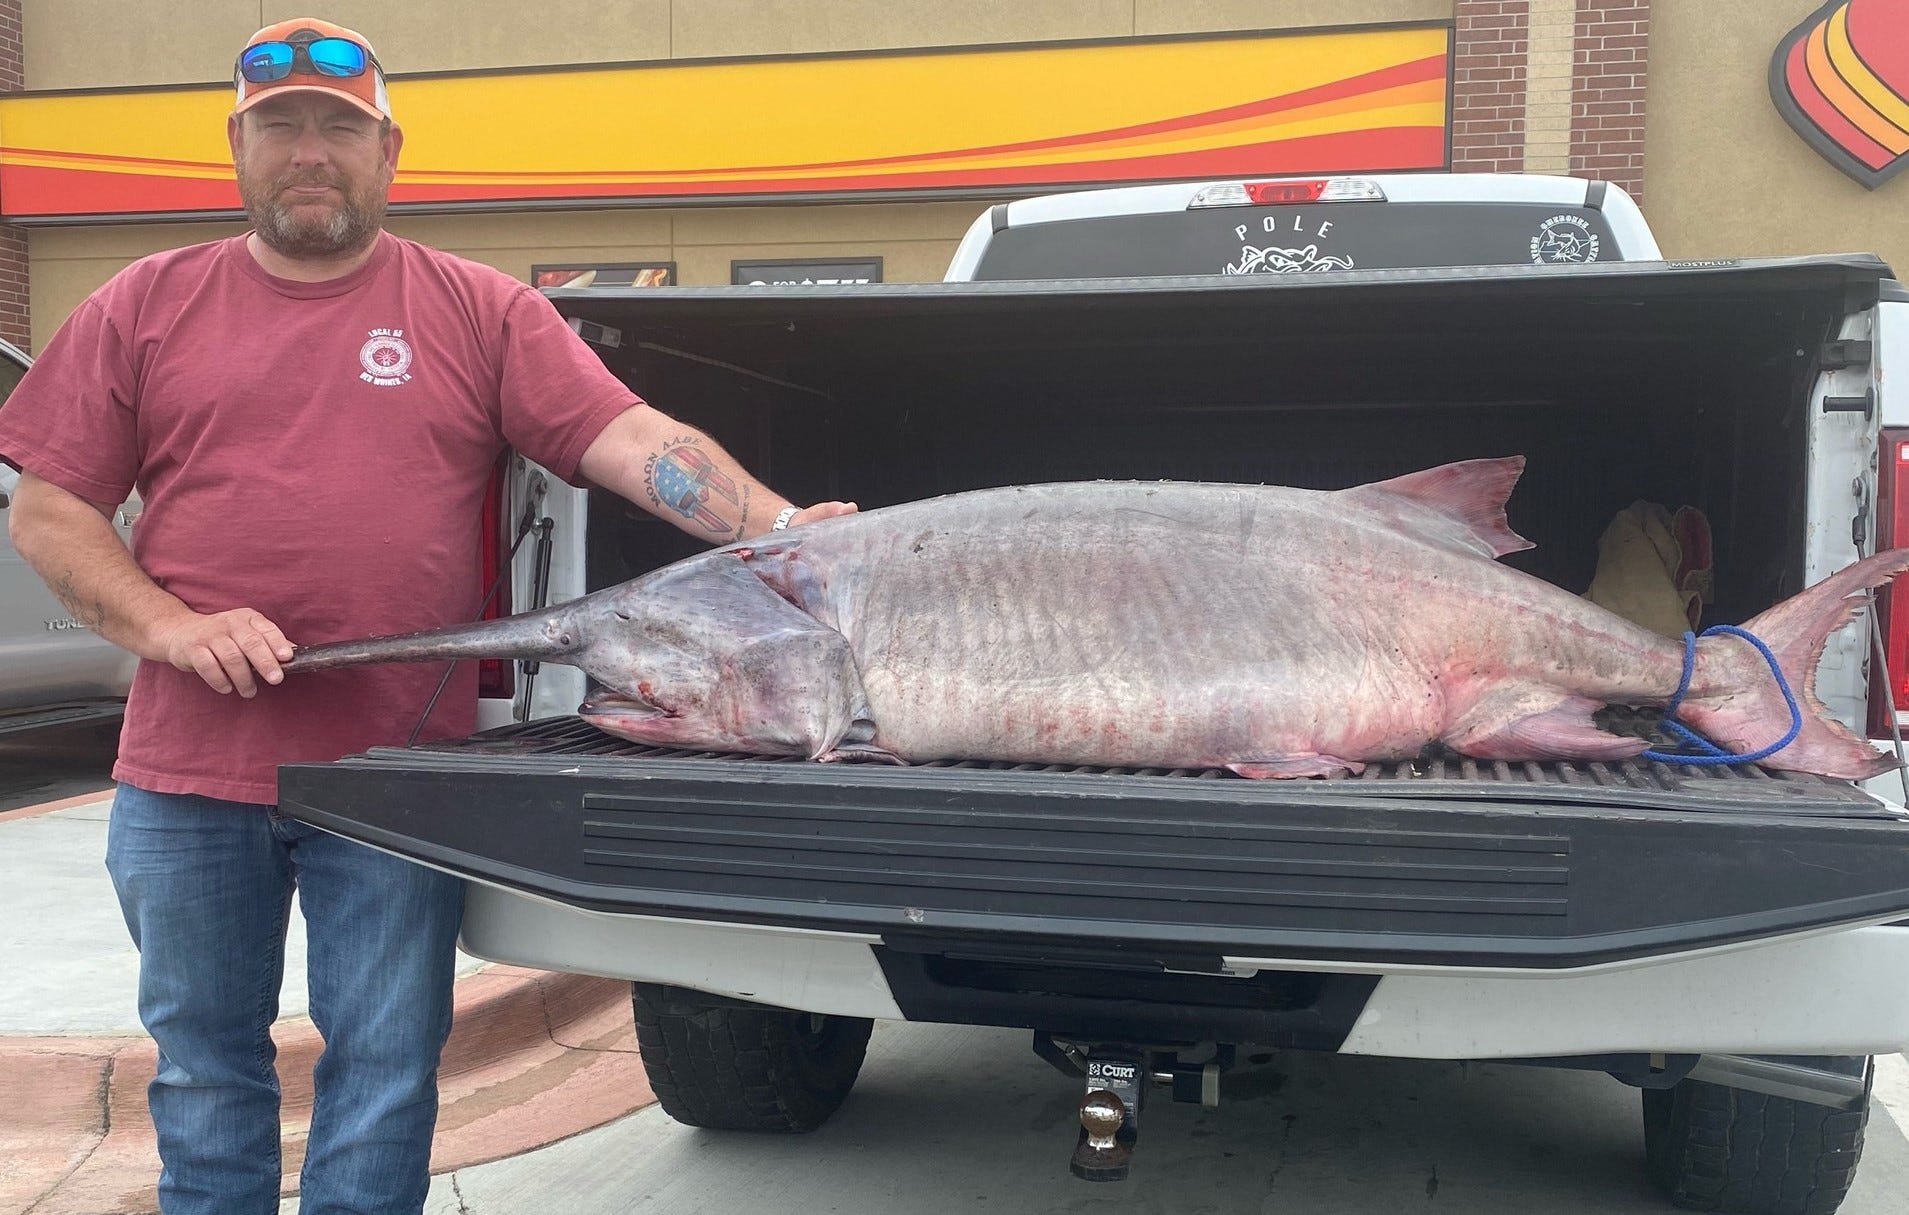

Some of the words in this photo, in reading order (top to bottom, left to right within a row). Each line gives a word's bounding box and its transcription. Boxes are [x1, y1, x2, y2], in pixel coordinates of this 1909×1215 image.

[1234, 215, 1333, 241] POLE
[1671, 259, 1734, 268] MOSTPLUS
[368, 328, 391, 337] LOCAL
[1102, 1064, 1135, 1078] CURT
